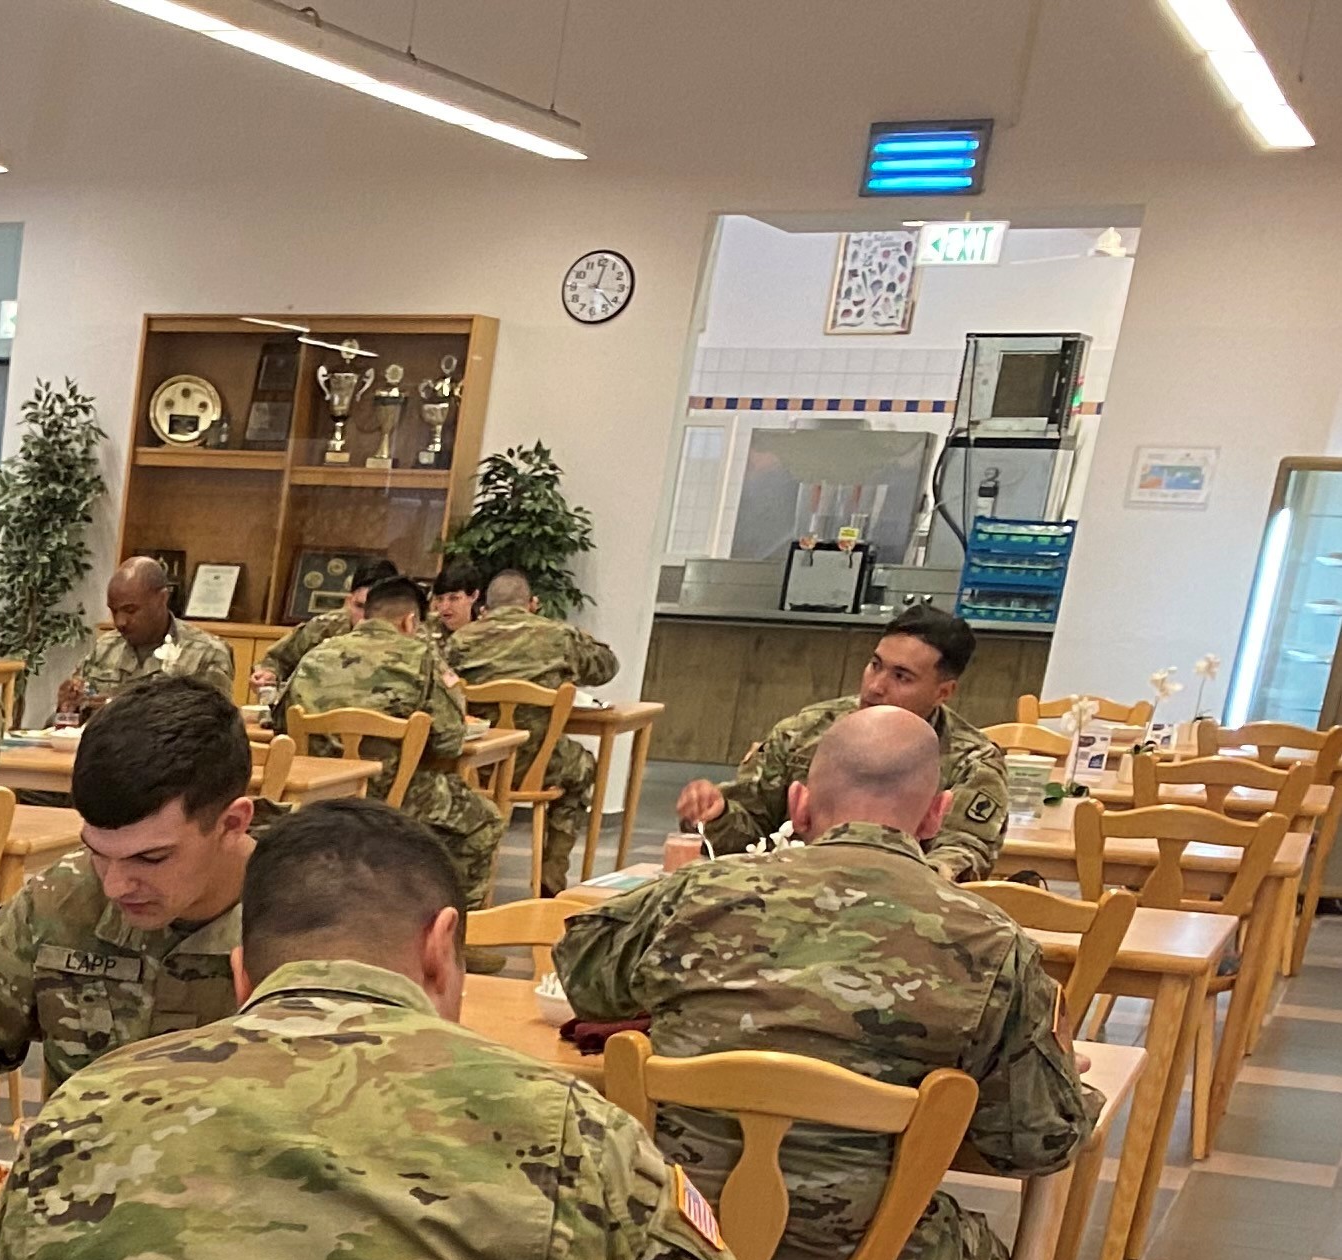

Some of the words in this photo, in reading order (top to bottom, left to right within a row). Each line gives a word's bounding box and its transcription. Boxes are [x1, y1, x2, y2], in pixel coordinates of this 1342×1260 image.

[941, 226, 995, 262] EXIT
[586, 262, 595, 270] 11
[611, 262, 616, 271] 1
[575, 270, 586, 279] 10
[616, 271, 624, 281] 2
[569, 282, 578, 291] 9
[617, 284, 626, 293] 3
[579, 303, 587, 312] 7
[588, 306, 596, 316] 6
[65, 953, 117, 973] LAPP
